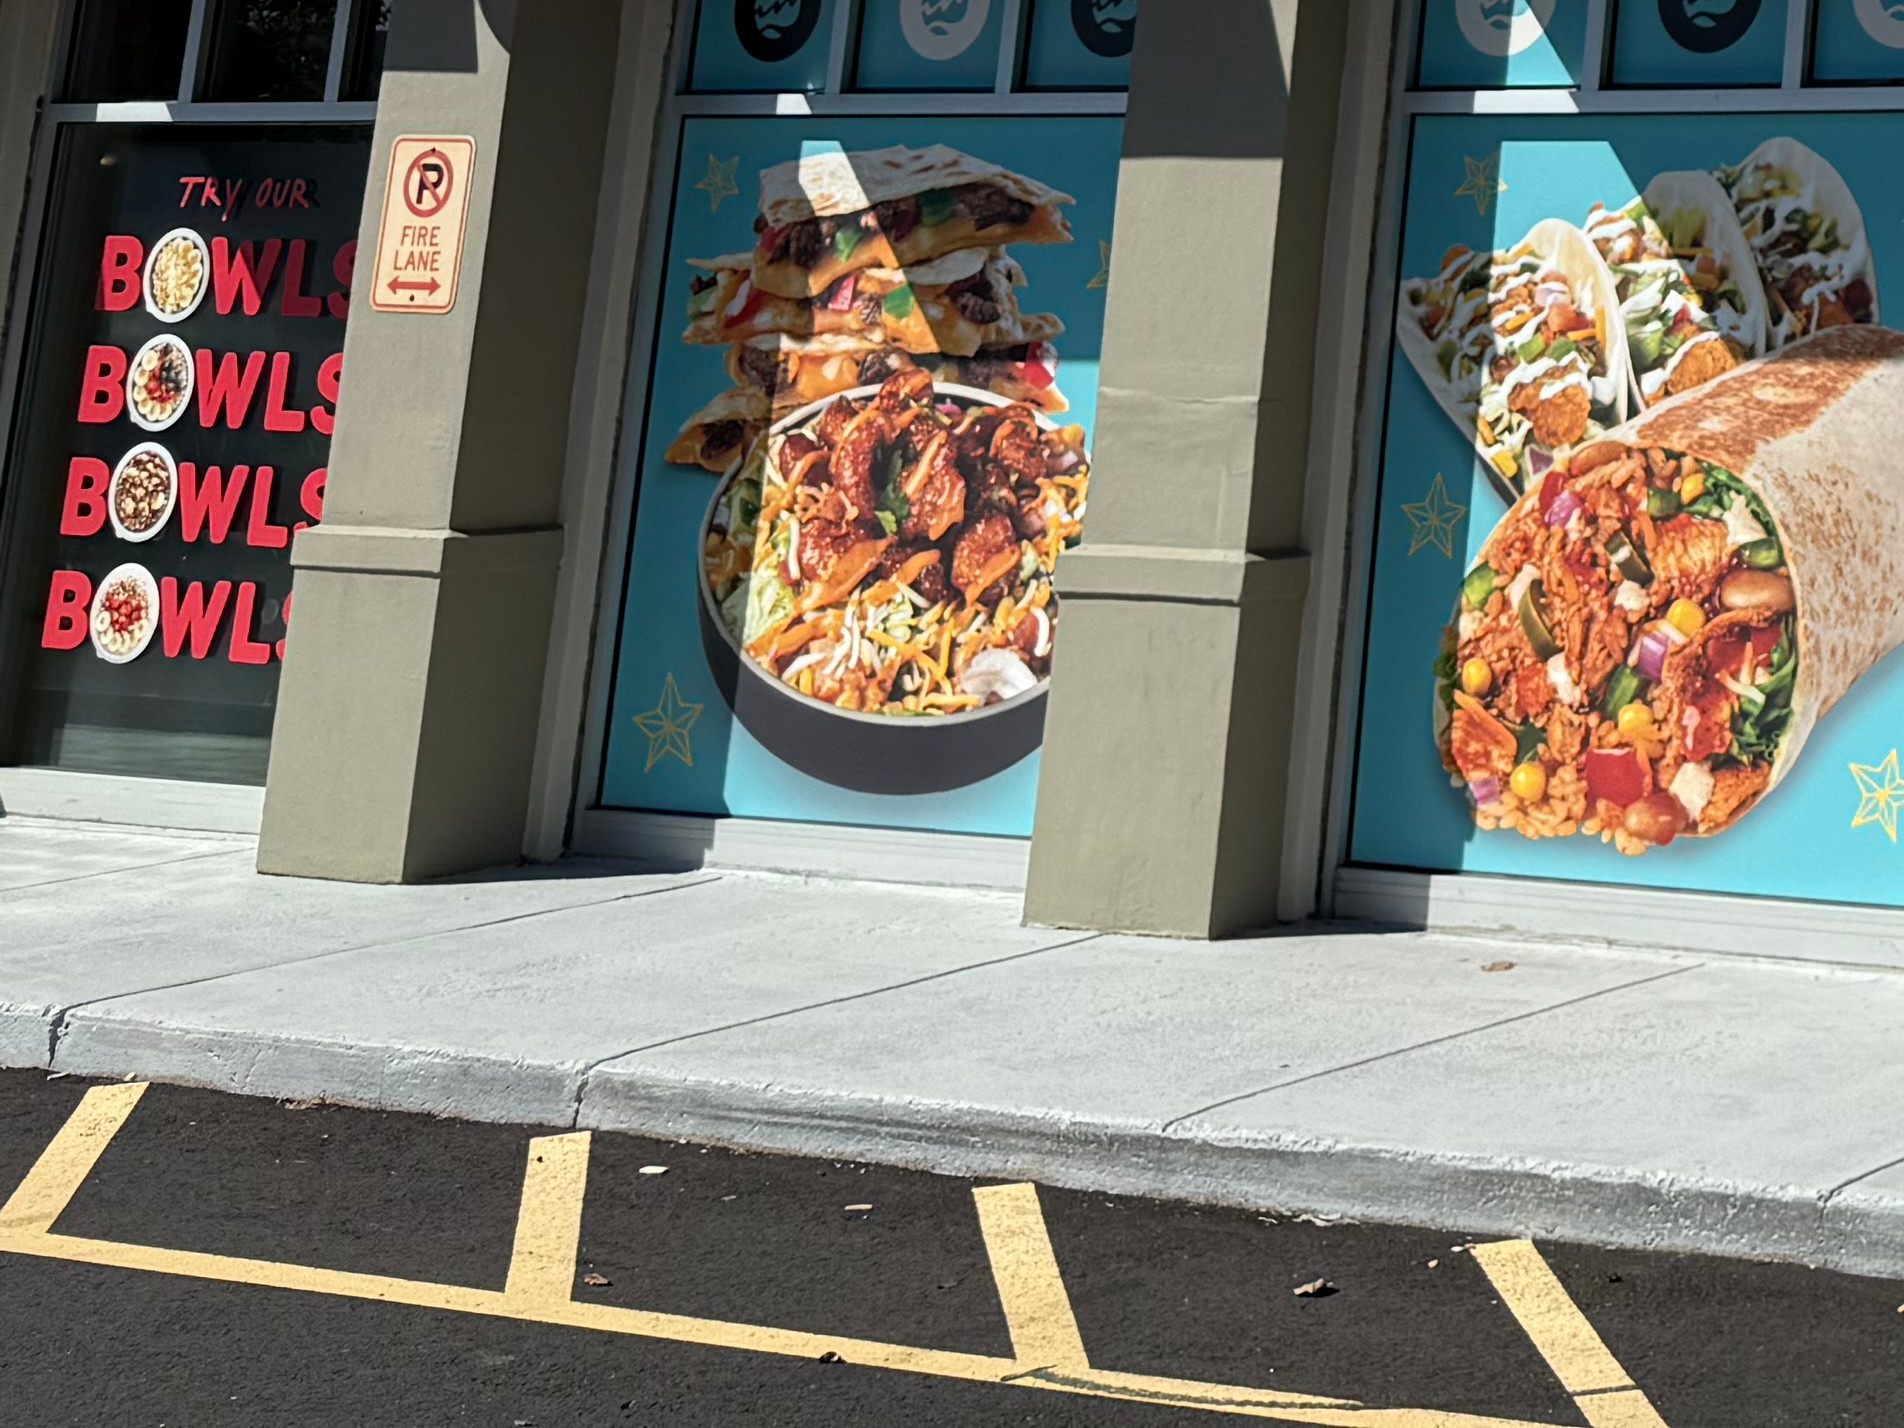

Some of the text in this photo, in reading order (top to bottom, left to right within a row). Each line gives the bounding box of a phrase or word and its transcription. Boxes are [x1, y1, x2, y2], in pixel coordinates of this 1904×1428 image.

[179, 176, 310, 222] TRY OUR
[400, 225, 441, 248] FIRE
[393, 249, 441, 272] LANE
[41, 562, 293, 665] BOWL
